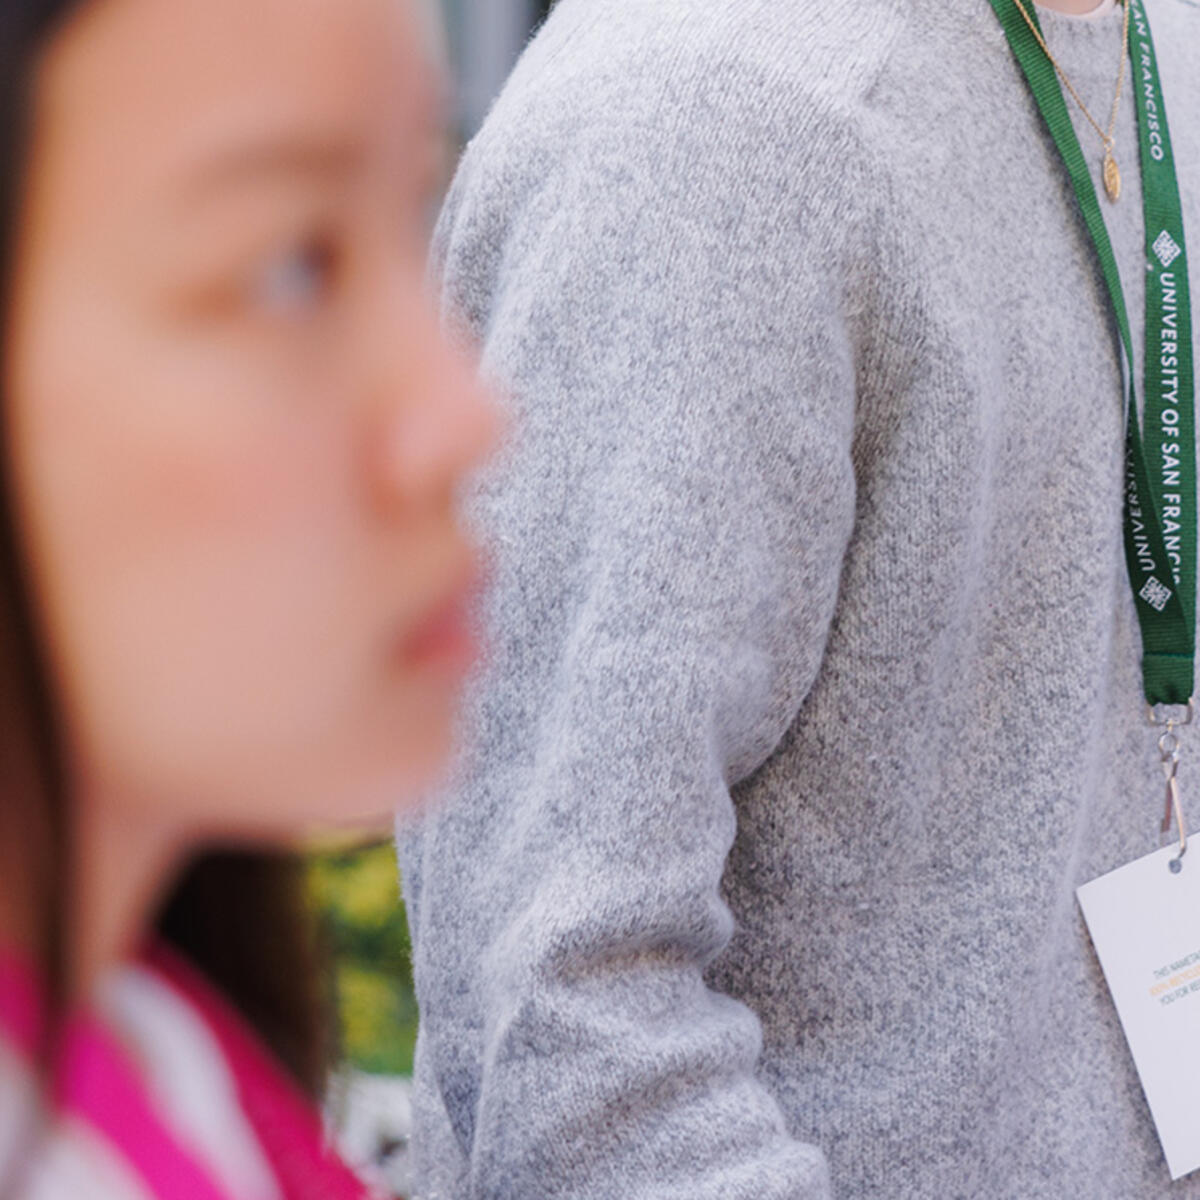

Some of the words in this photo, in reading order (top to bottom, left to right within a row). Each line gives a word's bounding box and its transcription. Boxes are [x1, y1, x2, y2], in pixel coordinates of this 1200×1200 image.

[1139, 41, 1164, 161] FRANCISCO
[1160, 273, 1179, 404] UNIVERSITY
[1161, 409, 1179, 438] OF
[1162, 443, 1181, 486] SAN
[1153, 966, 1170, 979] THIS
[1160, 993, 1175, 1006] YOU
[1175, 986, 1189, 999] FOR
